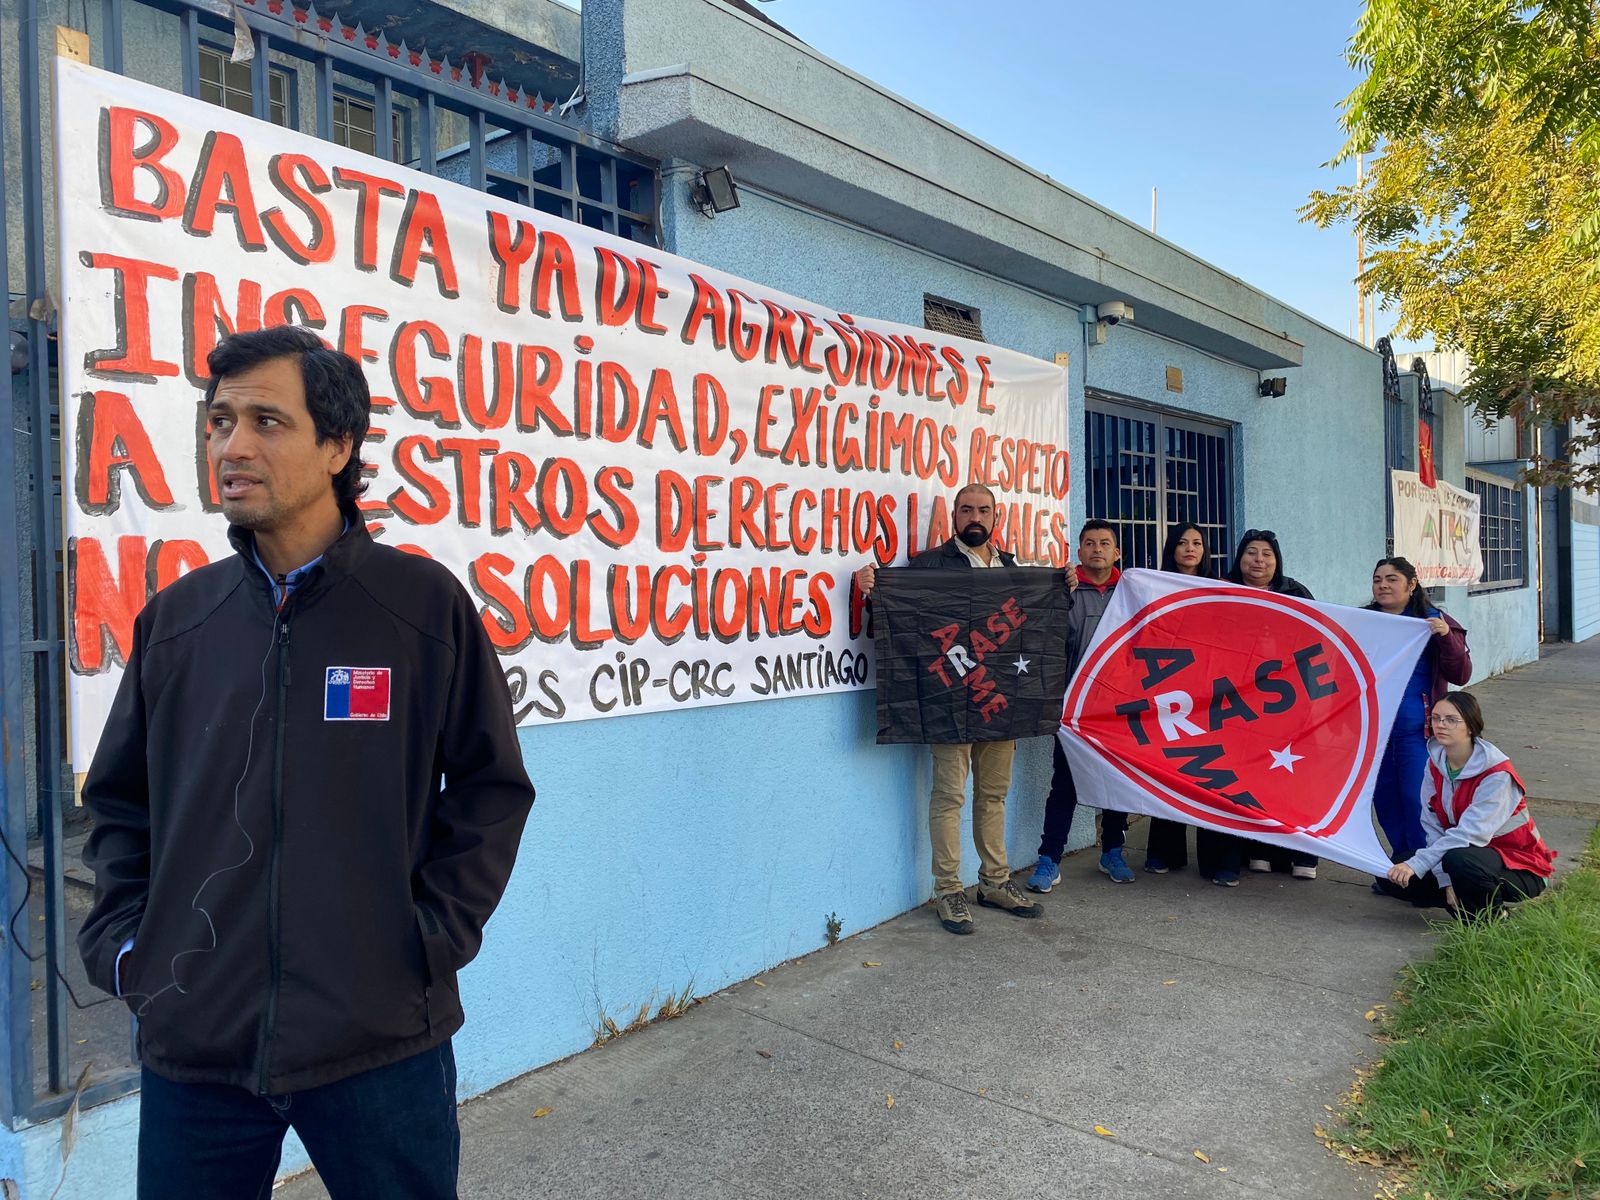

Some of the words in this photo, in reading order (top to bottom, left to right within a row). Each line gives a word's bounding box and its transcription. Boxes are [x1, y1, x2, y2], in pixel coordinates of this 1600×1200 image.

[97, 105, 459, 299] BASTA
[486, 210, 584, 323] YA
[594, 246, 669, 336] DE
[977, 355, 997, 416] E
[75, 390, 178, 517] A
[655, 468, 898, 568] DERECHOS
[907, 492, 1070, 569] LARALES
[967, 427, 1070, 501] RESPETO
